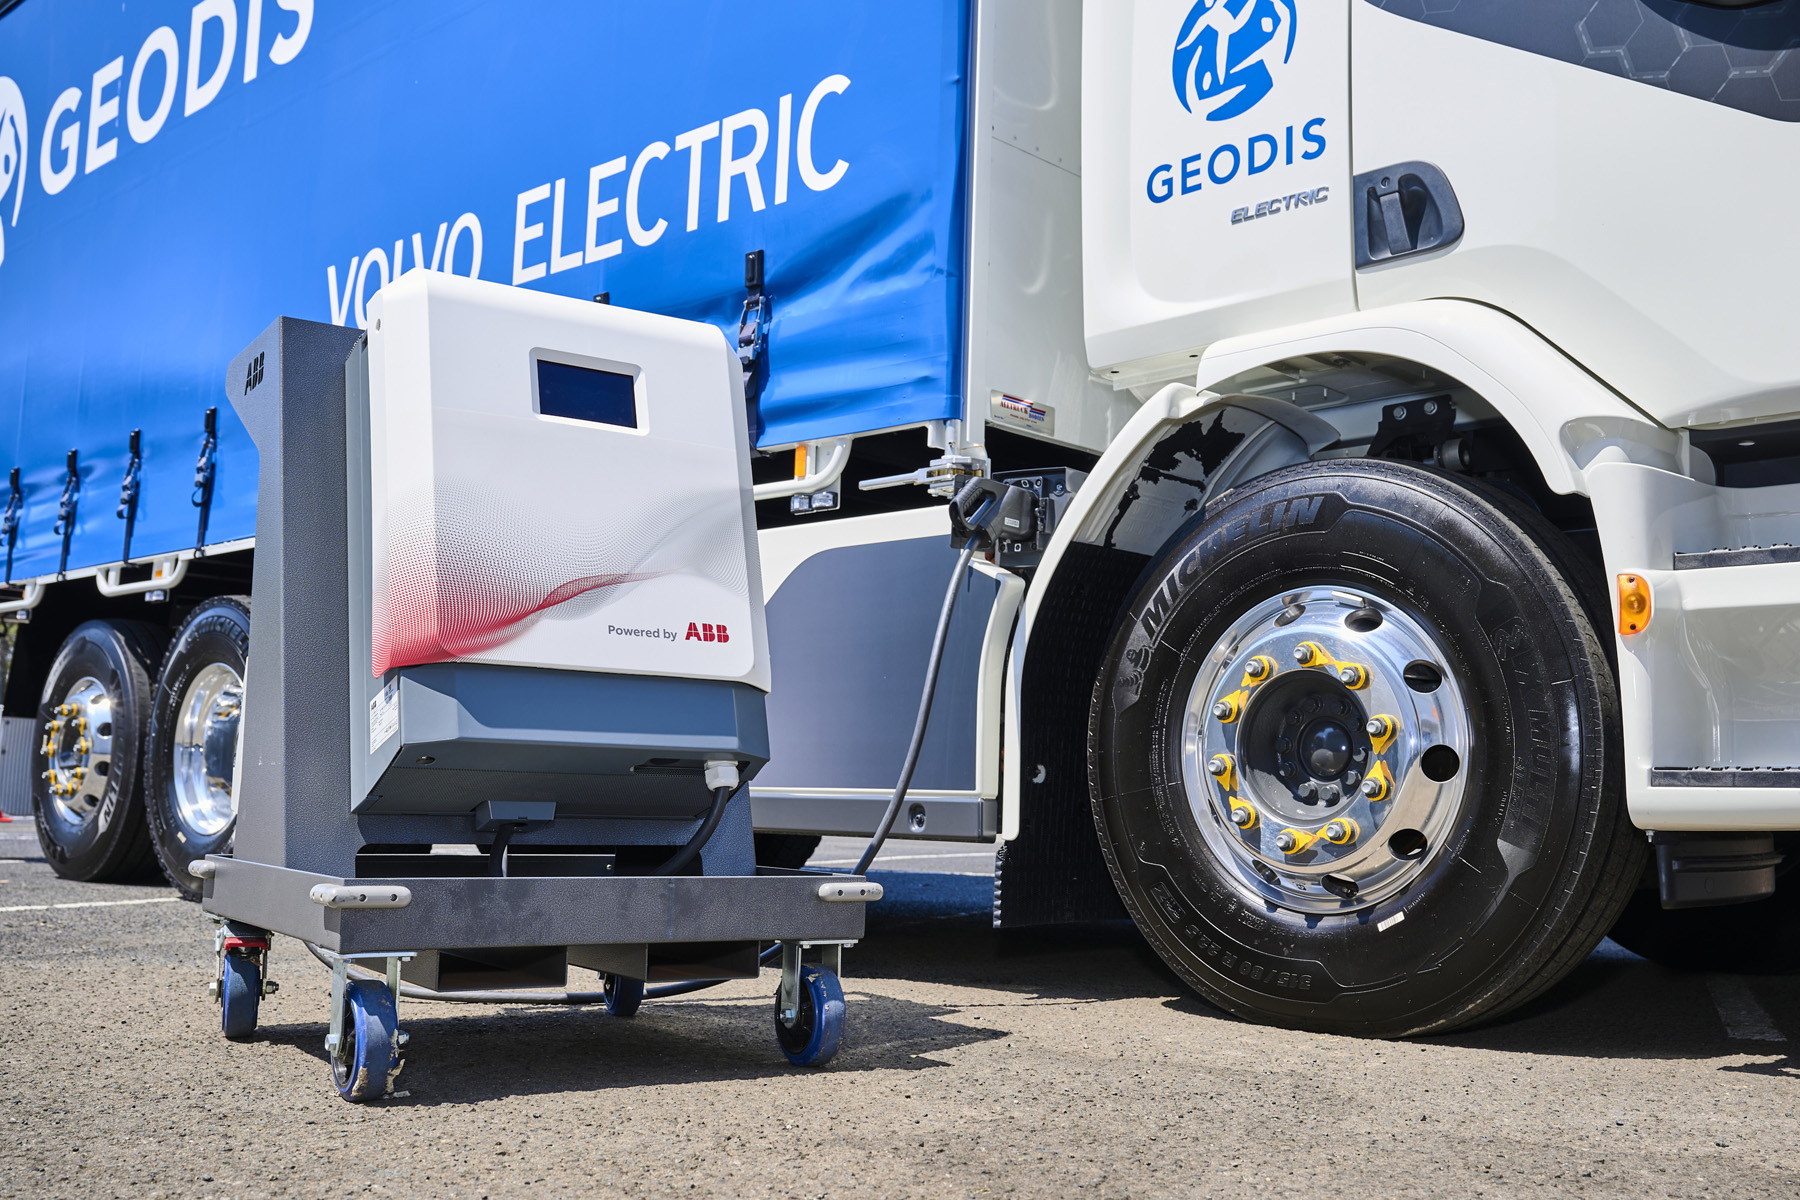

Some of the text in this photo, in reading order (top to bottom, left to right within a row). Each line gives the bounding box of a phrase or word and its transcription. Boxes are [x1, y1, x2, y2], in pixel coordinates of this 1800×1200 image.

[40, 0, 314, 195] GEODIS
[512, 74, 851, 286] ELECTRIC
[1146, 117, 1327, 204] GEODIS
[1230, 186, 1330, 225] ELECTRIC
[244, 351, 265, 396] ABB
[199, 615, 249, 659] MICHELI
[608, 622, 730, 643] Powered by ABB
